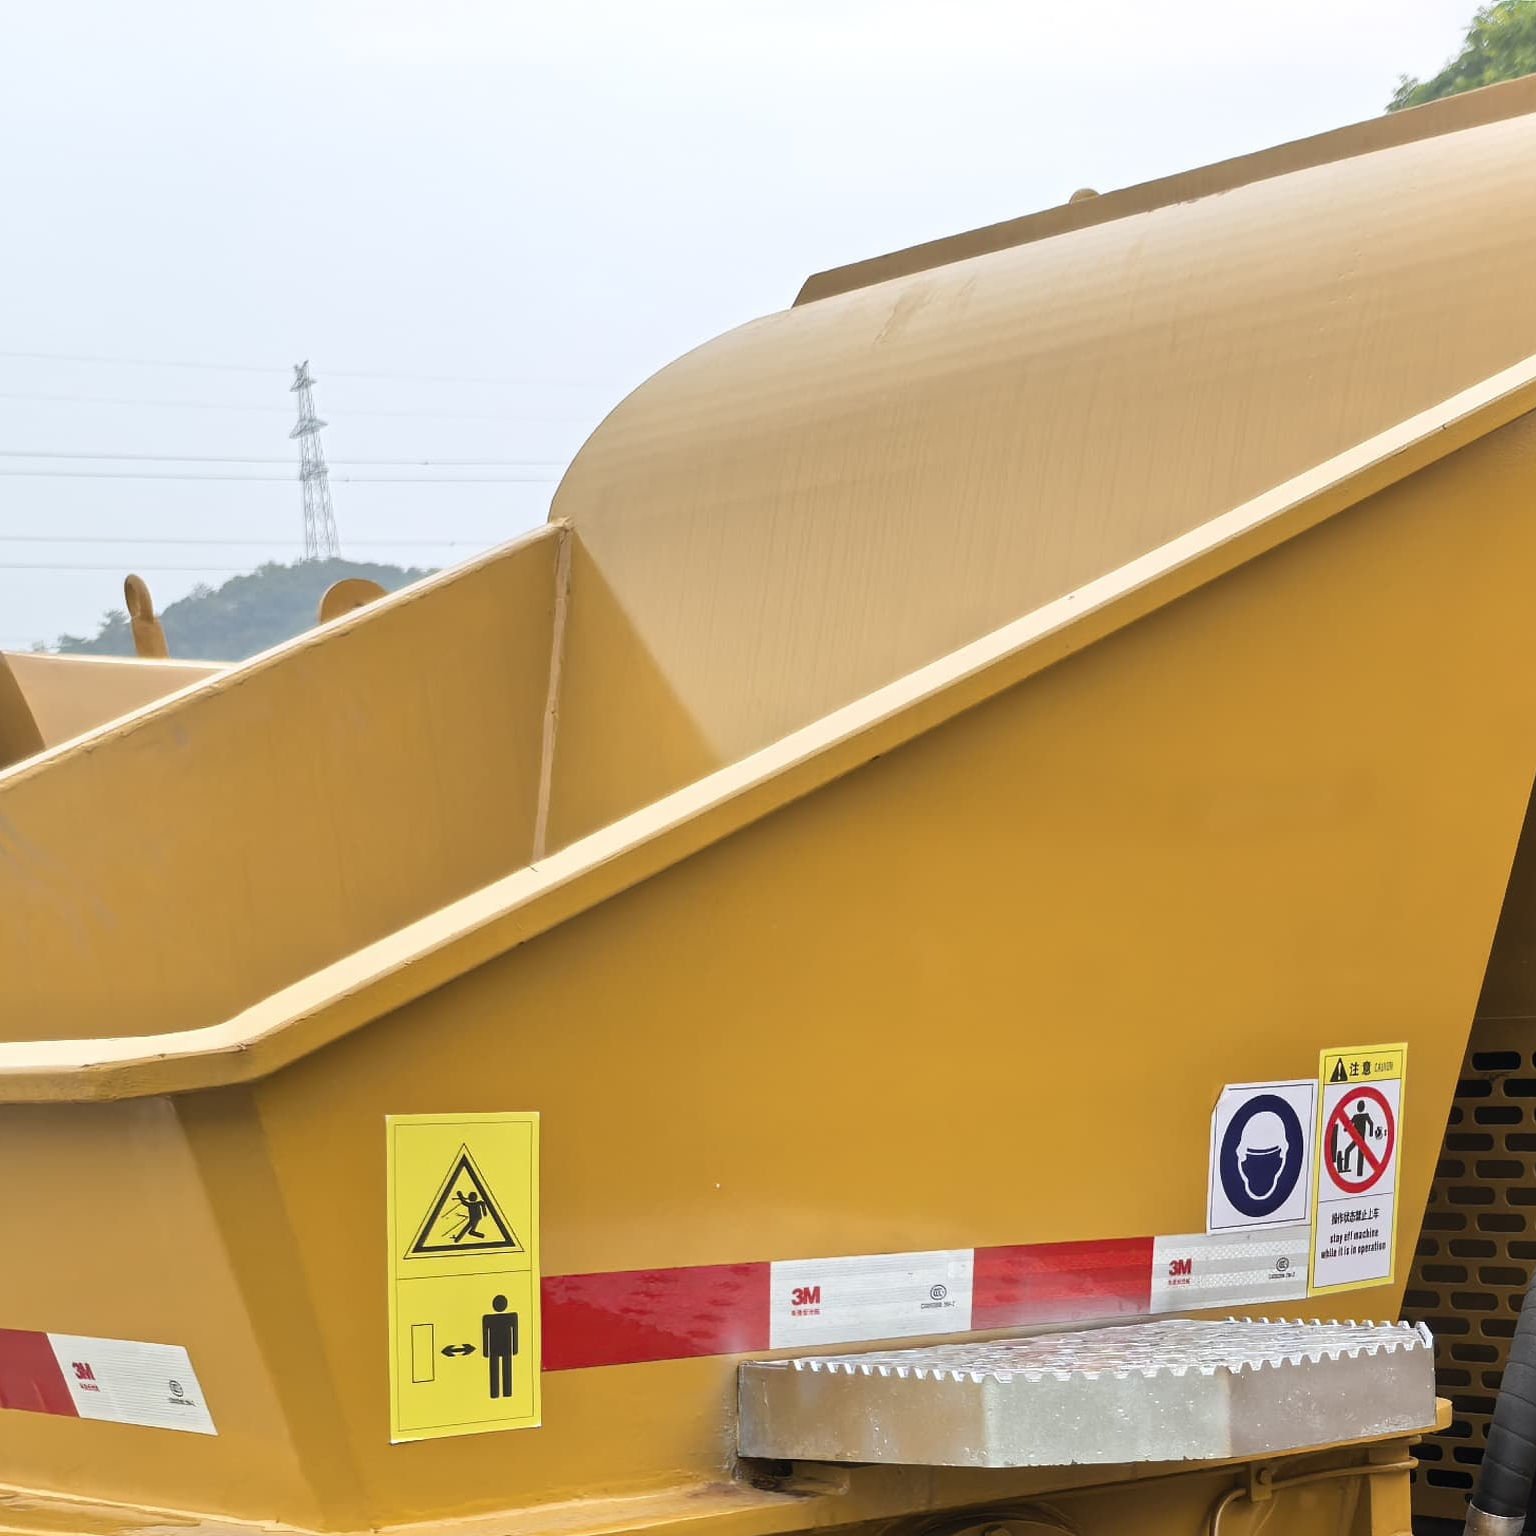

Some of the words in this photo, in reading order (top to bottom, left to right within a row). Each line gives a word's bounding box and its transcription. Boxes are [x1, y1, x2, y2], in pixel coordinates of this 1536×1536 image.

[1353, 1228, 1379, 1240] machine
[1168, 1258, 1192, 1276] 3M
[791, 1286, 821, 1306] 3M
[72, 1362, 96, 1380] 3M
